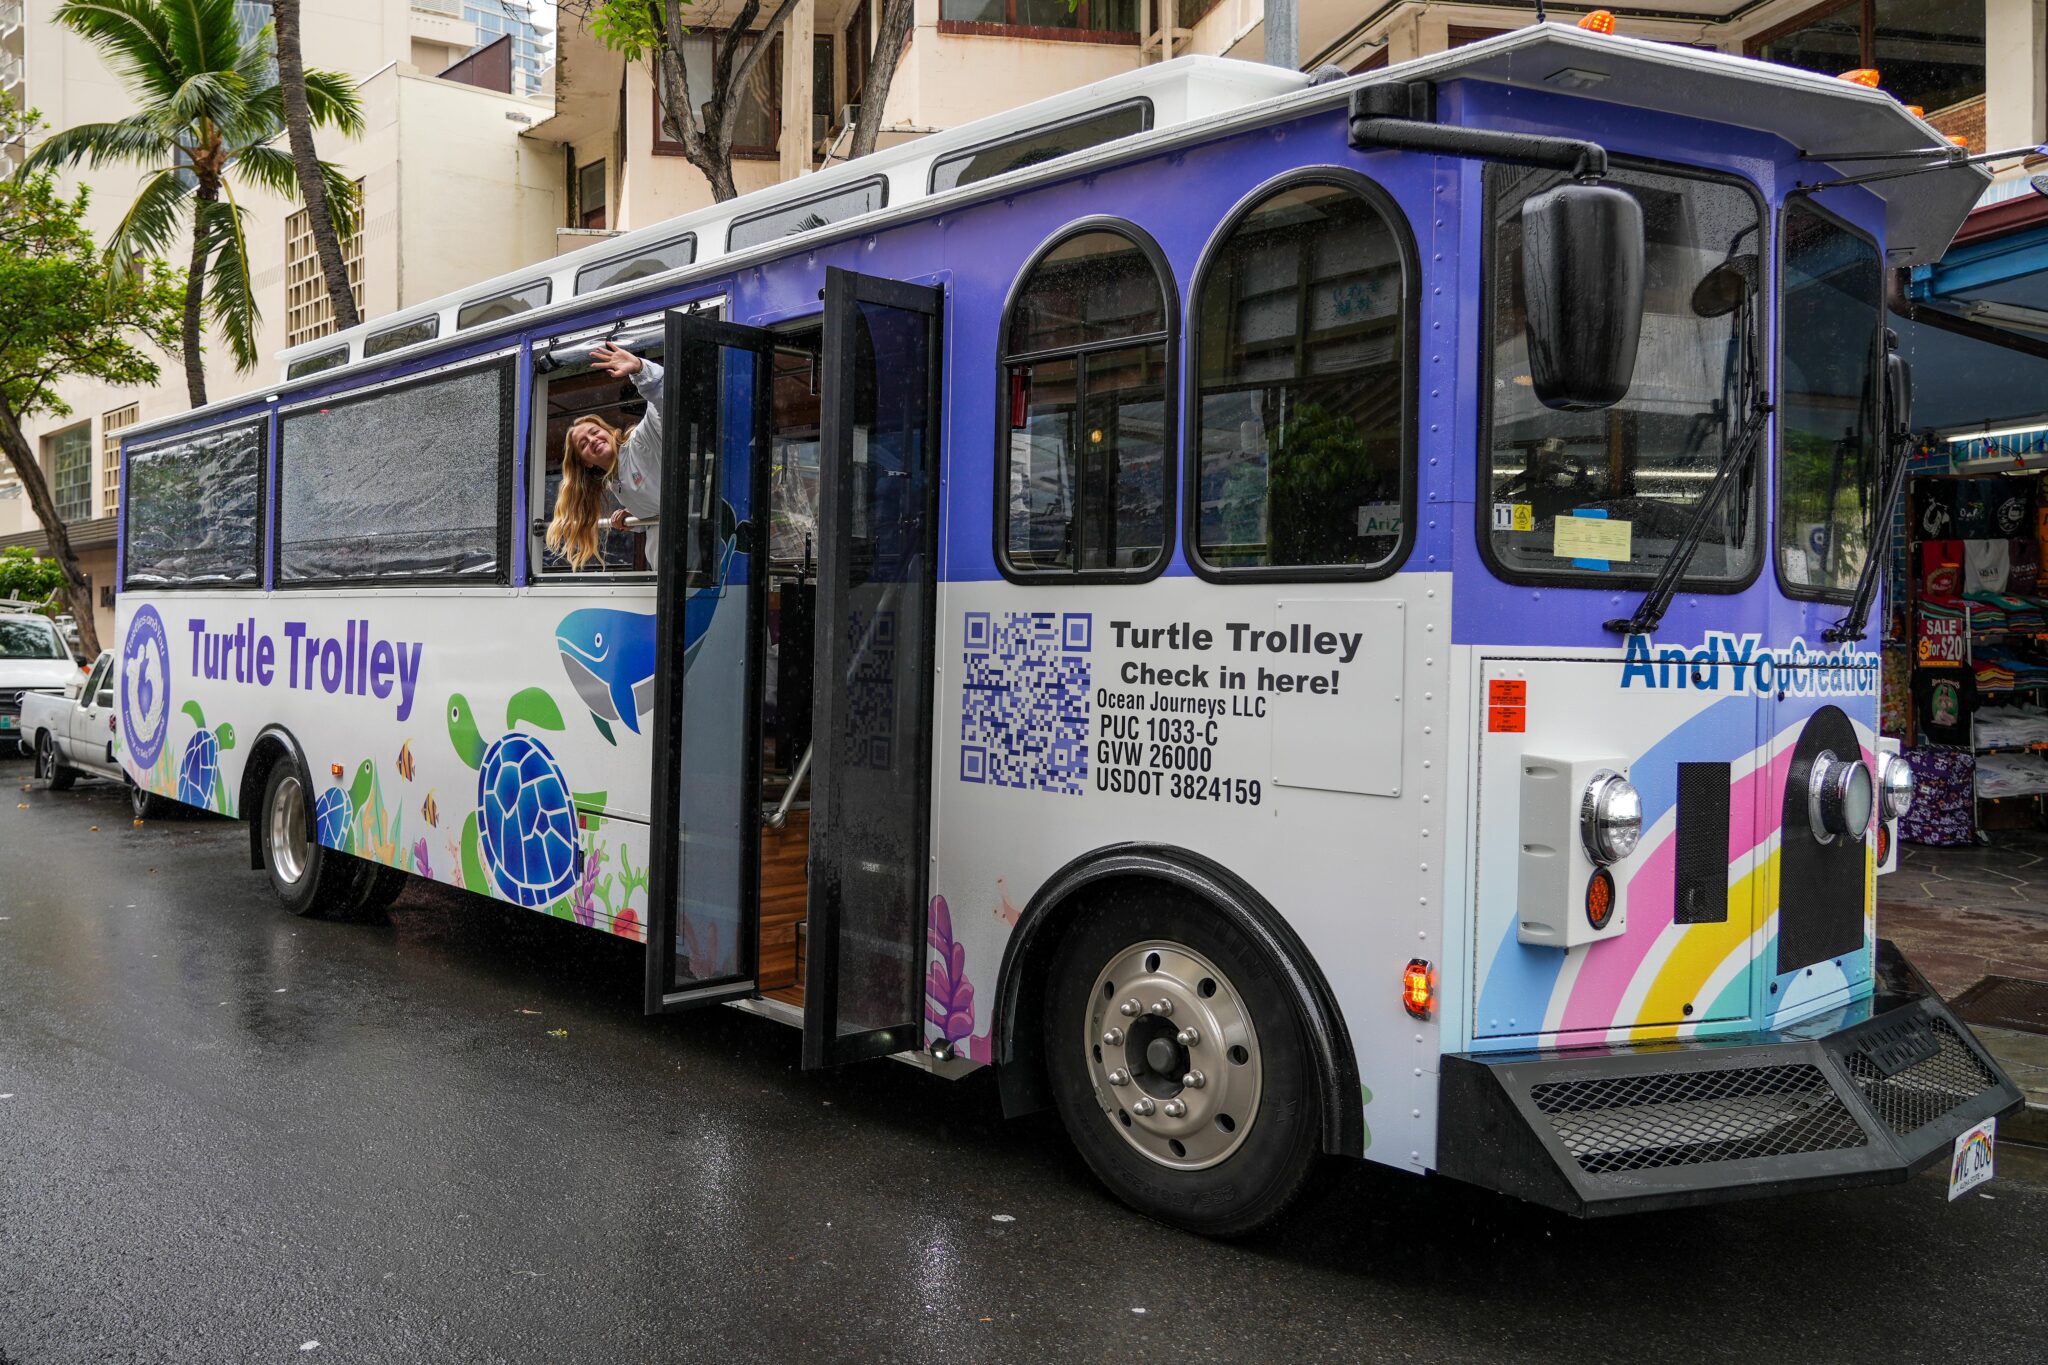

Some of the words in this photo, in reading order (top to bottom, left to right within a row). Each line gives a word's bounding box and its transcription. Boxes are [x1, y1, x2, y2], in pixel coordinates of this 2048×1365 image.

[1496, 509, 1511, 524] 11
[1110, 620, 1213, 651] Turtle
[1226, 622, 1363, 664] Trolley
[1926, 619, 1957, 635] SALE
[1930, 641, 1940, 656] for
[1941, 636, 1962, 660] $20
[188, 617, 275, 687] Turtle
[284, 619, 422, 722] Trolley
[1120, 660, 1209, 688] Check
[1219, 667, 1246, 690] in
[1258, 667, 1340, 696] here!
[1097, 687, 1145, 711] Ocean
[1149, 691, 1226, 717] Journeys
[1232, 694, 1266, 719] LLC
[1100, 714, 1139, 741] PUC
[1146, 717, 1218, 747] 1033-C
[1096, 739, 1143, 767] GVW
[1149, 743, 1212, 773] 26000
[1096, 766, 1165, 797] USDOT
[1170, 773, 1261, 806] 3824159
